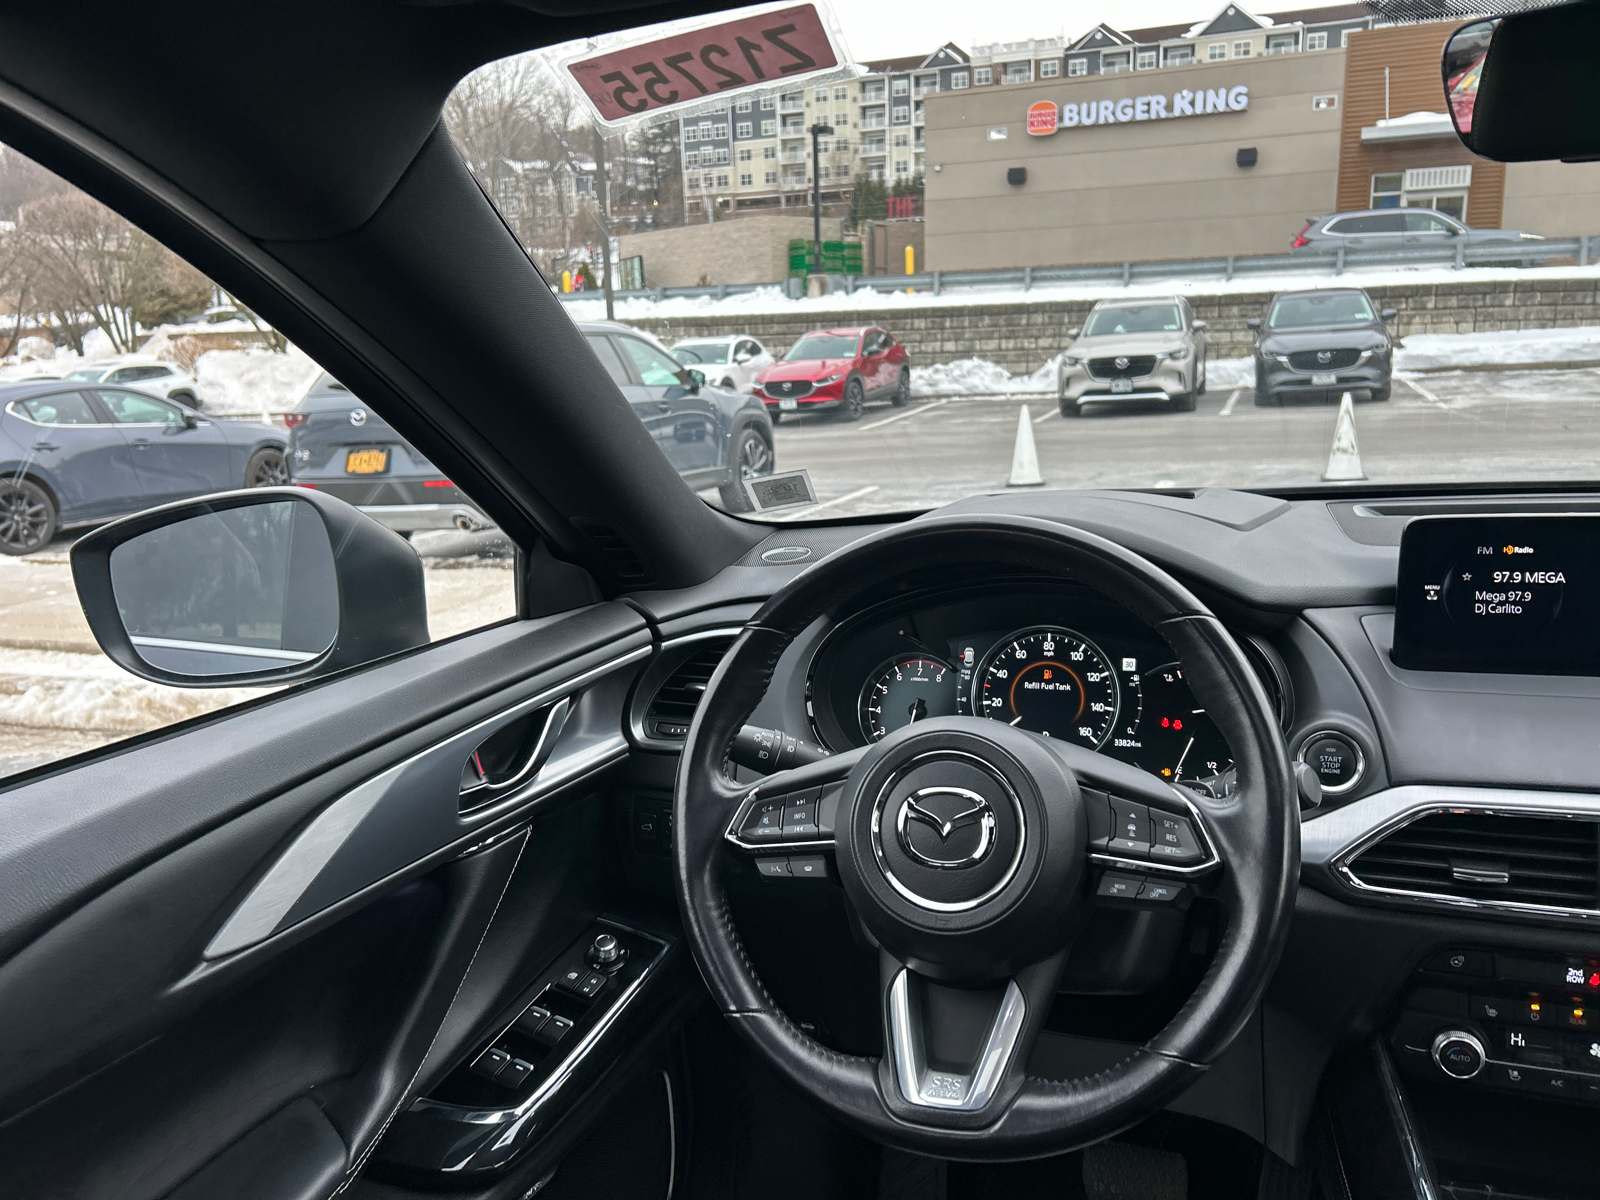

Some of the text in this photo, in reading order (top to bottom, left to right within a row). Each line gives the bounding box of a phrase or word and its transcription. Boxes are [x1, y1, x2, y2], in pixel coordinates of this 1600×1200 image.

[1063, 85, 1248, 127] BURGER KING
[1028, 111, 1057, 120] BURGER
[1028, 118, 1057, 129] KING
[885, 195, 917, 218] THE
[1477, 546, 1493, 555] FM
[1514, 546, 1534, 554] Radio
[1493, 571, 1566, 584] 97.9 MEGA
[1475, 591, 1532, 604] Mega 97.9
[1475, 604, 1523, 615] Dj Carlito
[1043, 642, 1054, 650] 80
[1015, 650, 1026, 658] 60
[1070, 652, 1084, 661] 100
[936, 674, 942, 682] 8
[996, 670, 1008, 678] 40
[1087, 672, 1100, 682] 120
[882, 686, 888, 694] 5
[1041, 682, 1054, 690] Fuel
[992, 698, 1002, 706] 20
[876, 706, 881, 714] 4
[1090, 703, 1104, 712] 140
[880, 726, 886, 734] 3
[1078, 728, 1092, 736] 160
[1166, 834, 1177, 842] RES
[1568, 968, 1584, 976] 2nd
[1566, 975, 1585, 984] ROW
[1570, 1018, 1587, 1026] REAR
[1450, 1054, 1470, 1063] AUTO
[932, 1076, 961, 1090] SRS
